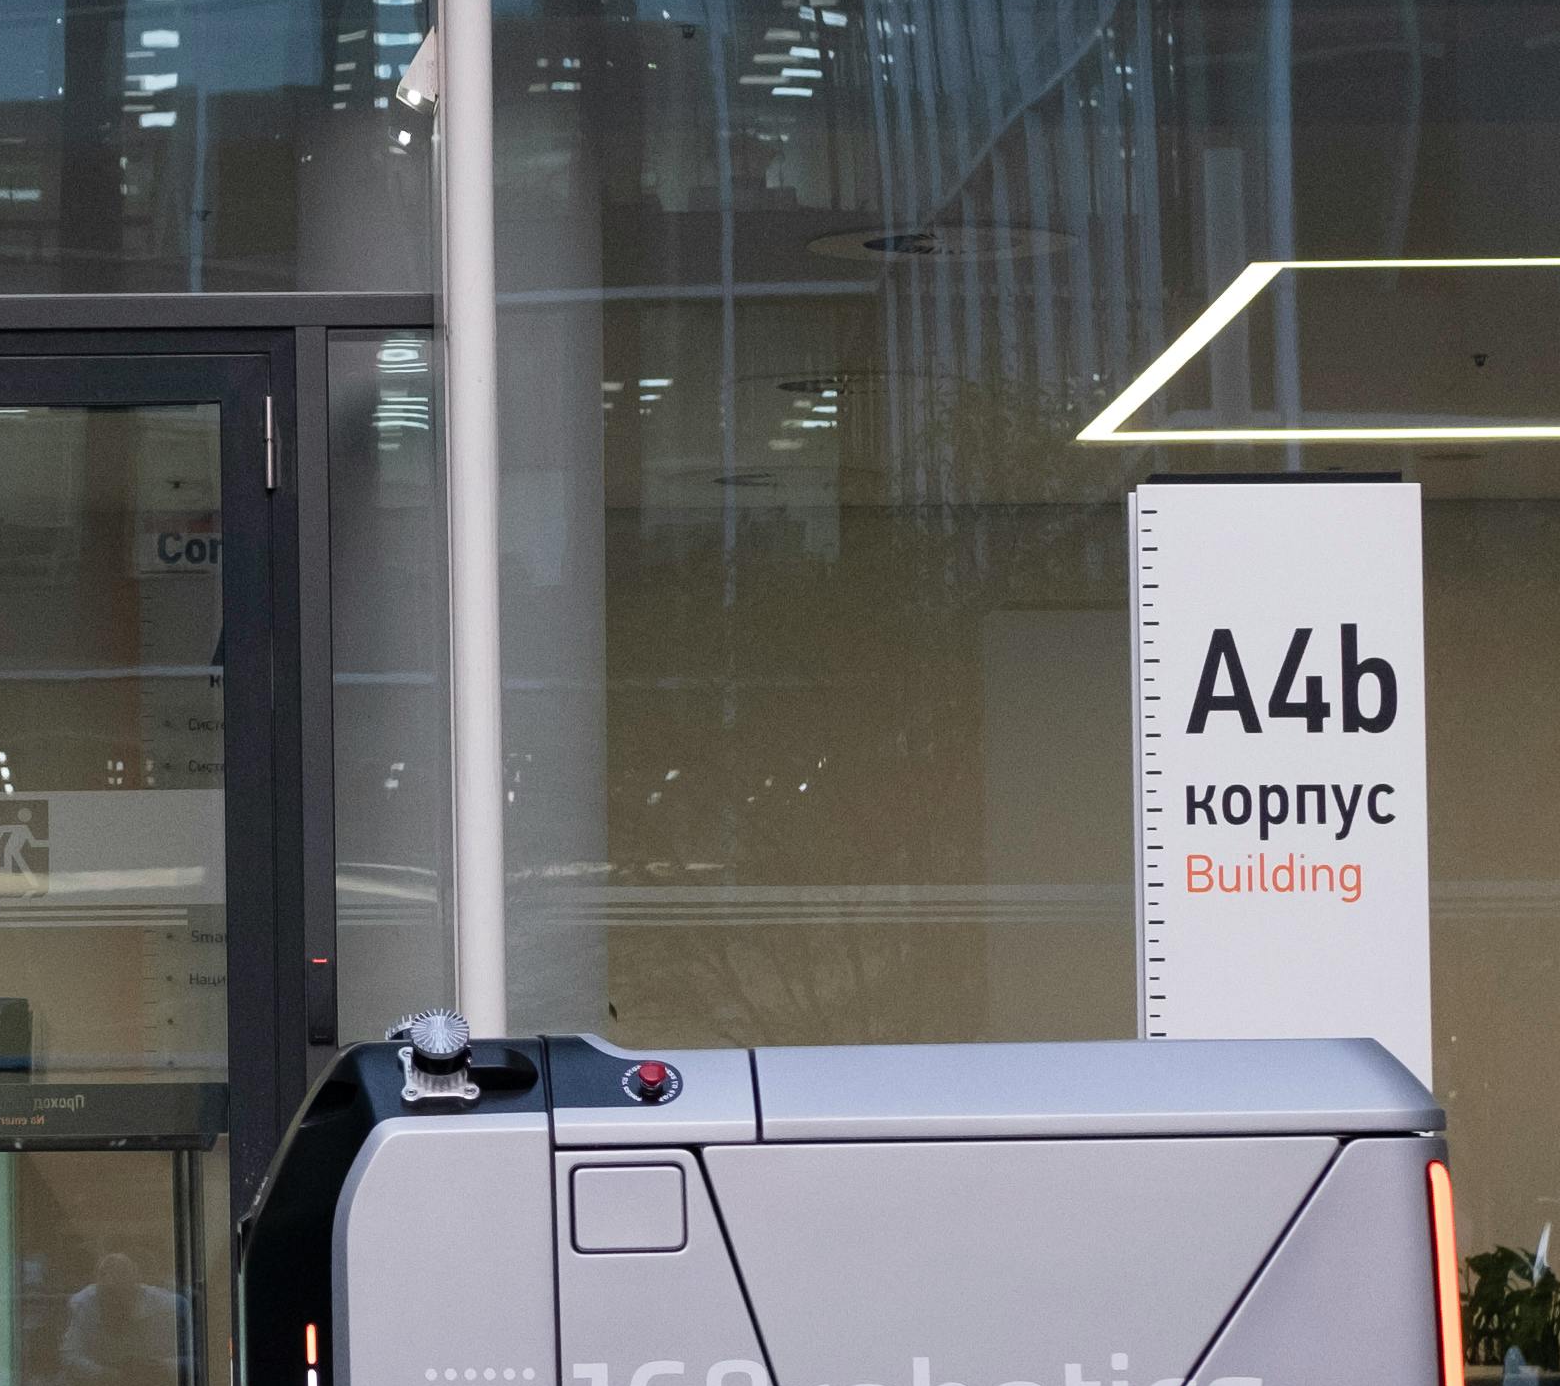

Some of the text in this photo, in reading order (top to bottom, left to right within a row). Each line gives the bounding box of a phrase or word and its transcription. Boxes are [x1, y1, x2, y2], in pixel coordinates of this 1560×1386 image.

[1185, 623, 1398, 734] A4b
[1185, 782, 1396, 840] корпус
[1186, 852, 1363, 903] Building
